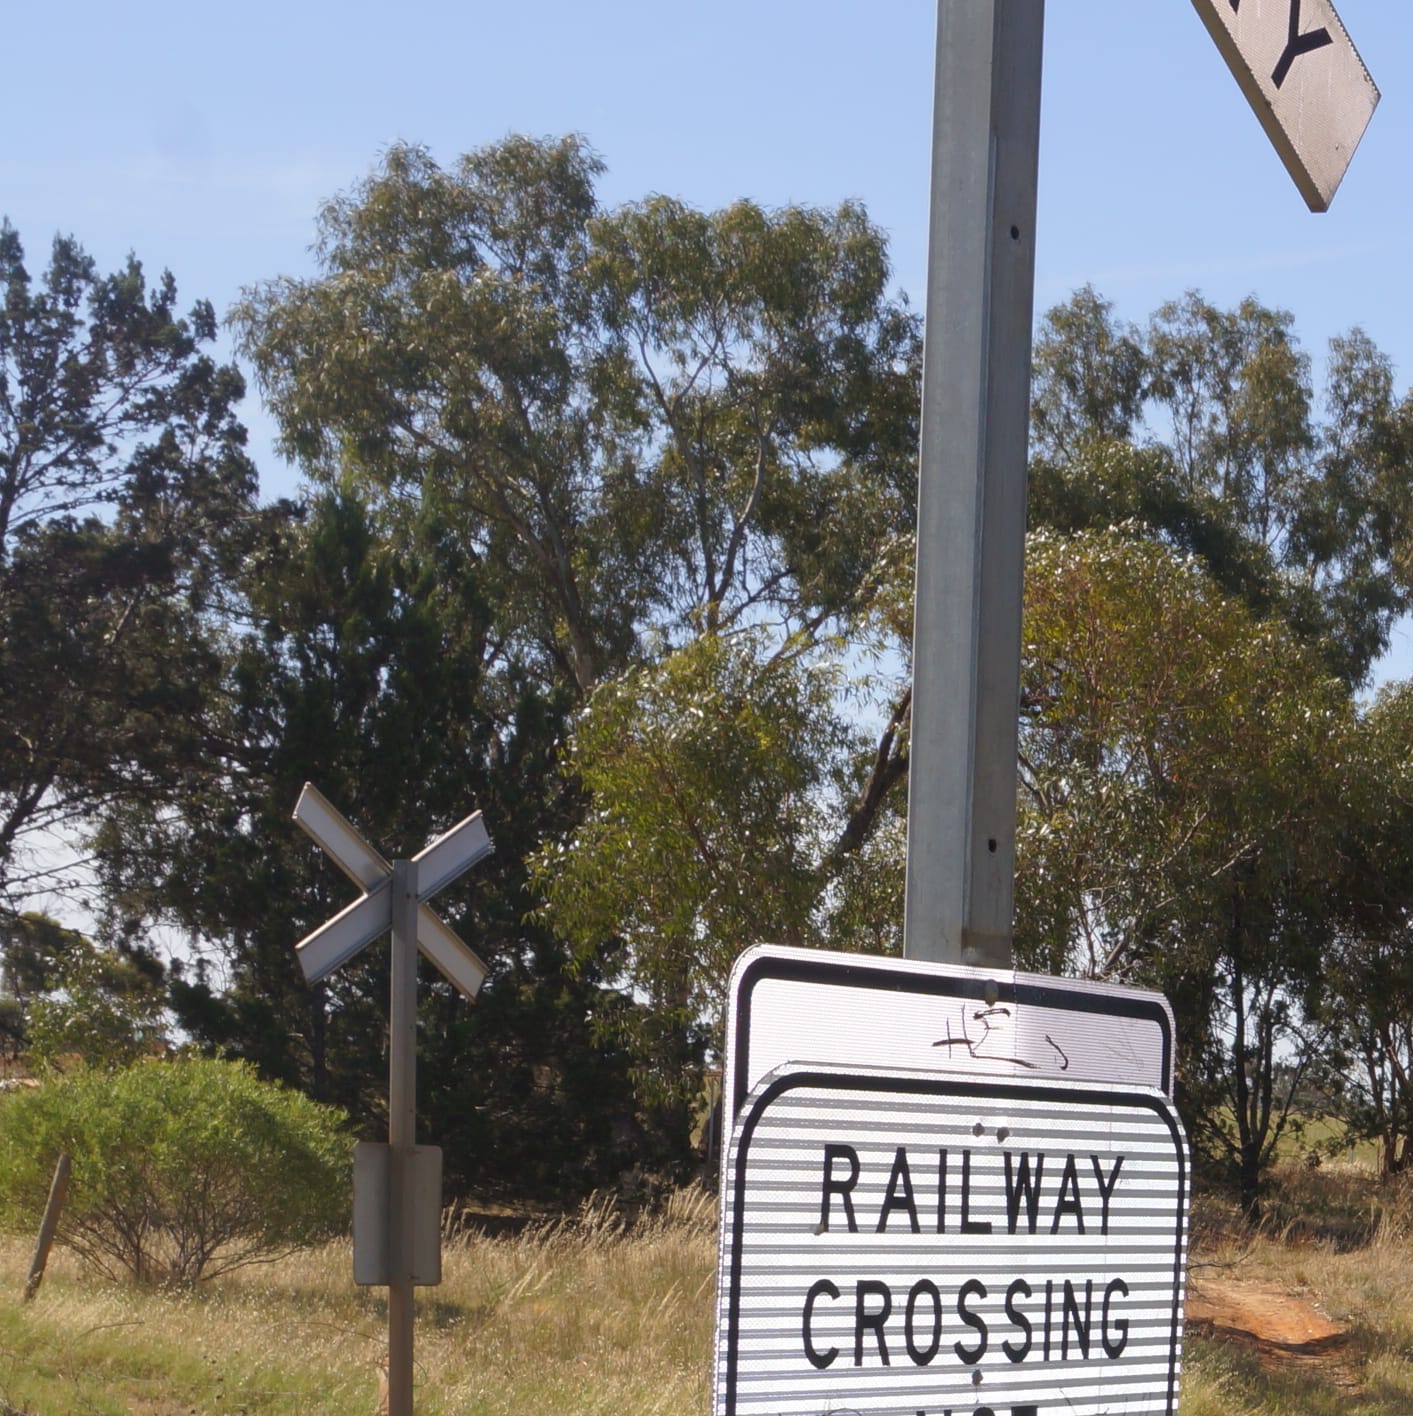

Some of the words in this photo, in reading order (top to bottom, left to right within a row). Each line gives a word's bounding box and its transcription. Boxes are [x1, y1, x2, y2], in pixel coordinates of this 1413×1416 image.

[1229, 0, 1334, 90] Y
[820, 1144, 1125, 1236] RAILWAY
[801, 1278, 1130, 1370] CROSSING
